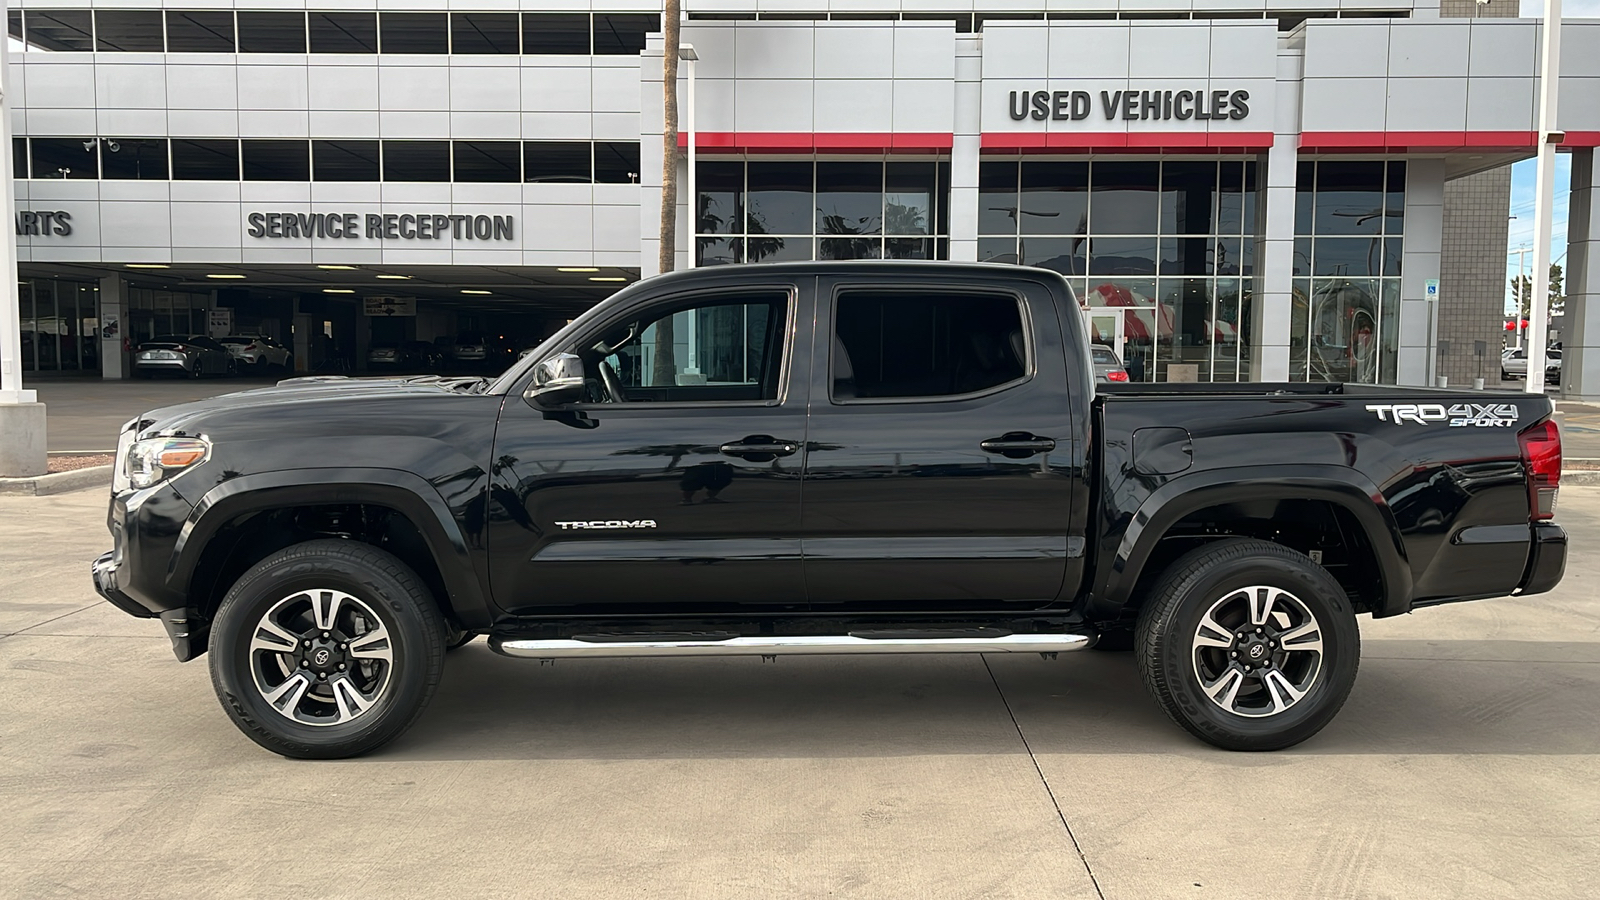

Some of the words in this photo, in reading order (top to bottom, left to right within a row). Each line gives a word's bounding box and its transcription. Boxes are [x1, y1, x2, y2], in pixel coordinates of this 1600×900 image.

[1009, 90, 1091, 120] USED
[1100, 90, 1250, 120] VEHICLES
[248, 212, 359, 239] SERVICE
[365, 213, 514, 240] RECEPTION
[1365, 404, 1448, 425] TRD
[1449, 417, 1518, 427] SPORT
[554, 519, 657, 530] TACOMA
